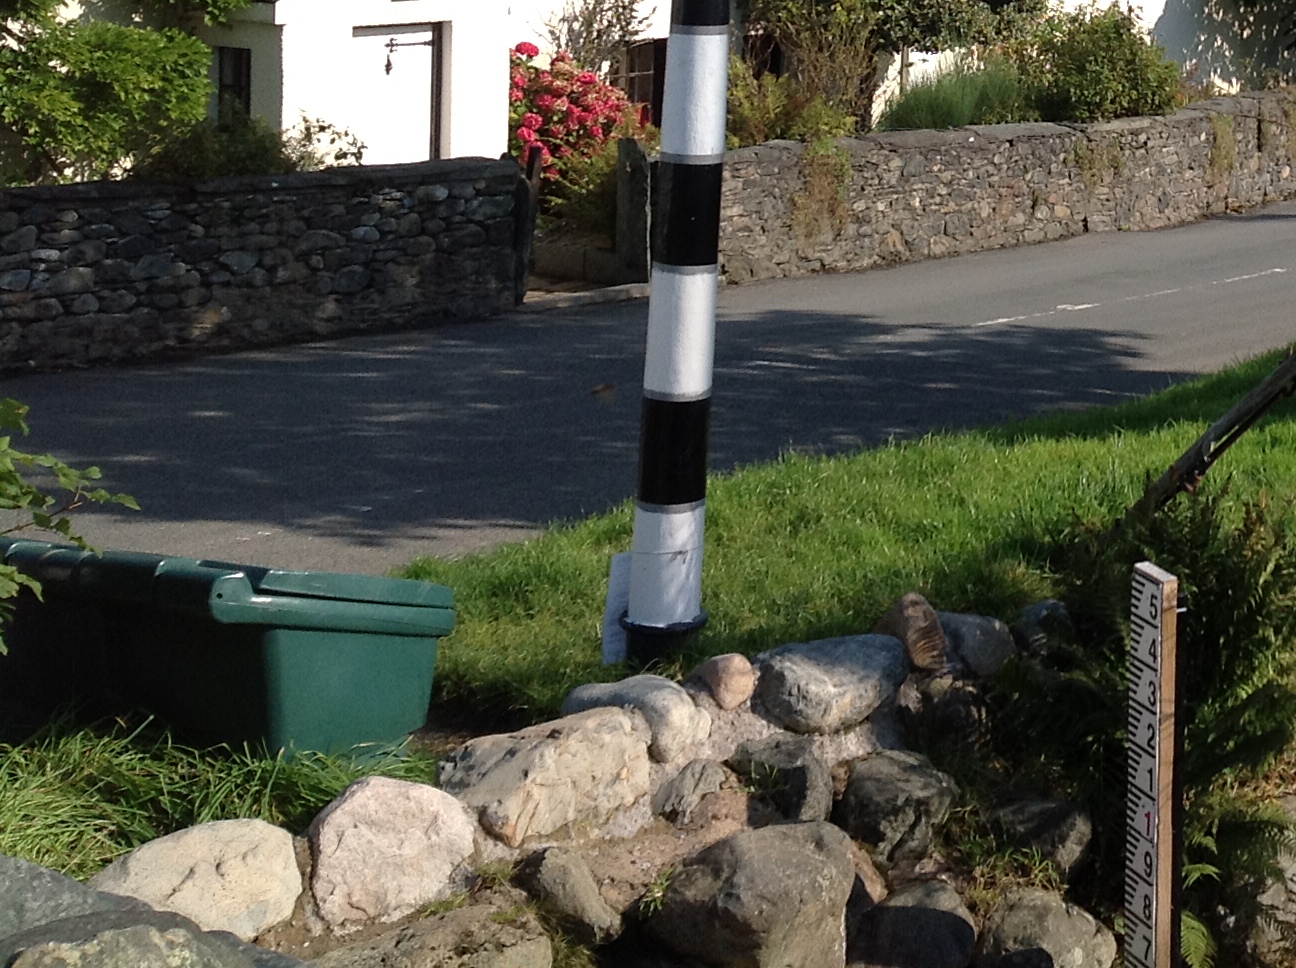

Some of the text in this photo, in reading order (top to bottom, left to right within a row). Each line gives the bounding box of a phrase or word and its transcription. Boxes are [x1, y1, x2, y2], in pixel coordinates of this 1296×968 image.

[1149, 594, 1158, 620] 5
[1148, 638, 1157, 664] 4
[1147, 680, 1156, 707] 3
[1146, 723, 1155, 750] 2
[1147, 767, 1153, 793] 1
[1144, 811, 1151, 836] 1
[1143, 851, 1153, 878] 9
[1142, 894, 1152, 921] 8
[1142, 935, 1152, 961] 7
